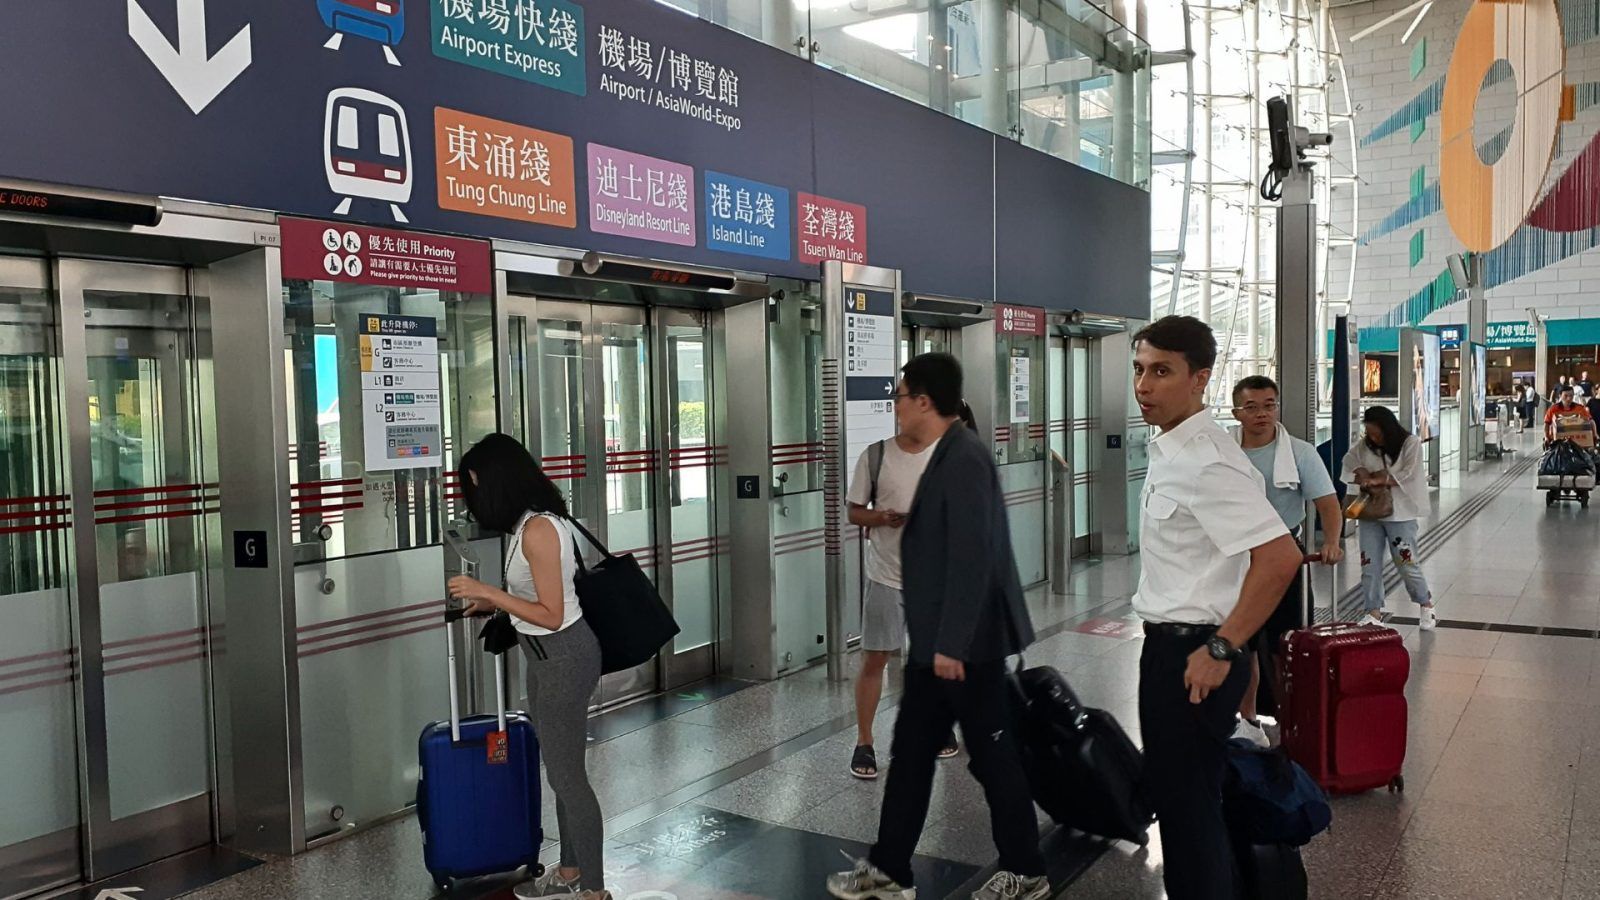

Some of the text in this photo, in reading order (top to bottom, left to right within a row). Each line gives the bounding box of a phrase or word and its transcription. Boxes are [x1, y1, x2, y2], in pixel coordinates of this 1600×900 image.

[441, 25, 561, 77] Airport Express
[598, 25, 739, 108] 機場/博覽館
[600, 73, 741, 131] Airport / AsiaWorld-Expo
[444, 124, 551, 187] 東涌綫
[445, 176, 566, 215] Tung Chung Line
[596, 156, 688, 213] 迪士尼綫
[11, 193, 48, 208] DOORS
[710, 182, 775, 229] 港島綫
[596, 203, 690, 236] Disneyland Resort Line
[802, 202, 855, 244] 荃灣綫
[368, 234, 456, 260] 優先使用 Priority
[712, 224, 765, 248] Island Line
[802, 240, 863, 263] Tsuen Wan Line
[370, 270, 387, 278] Please
[388, 272, 399, 280] give
[400, 273, 418, 281] priority
[374, 348, 380, 357] G
[374, 376, 382, 386] L1
[375, 404, 384, 413] L2
[744, 480, 752, 492] G
[245, 538, 256, 557] G
